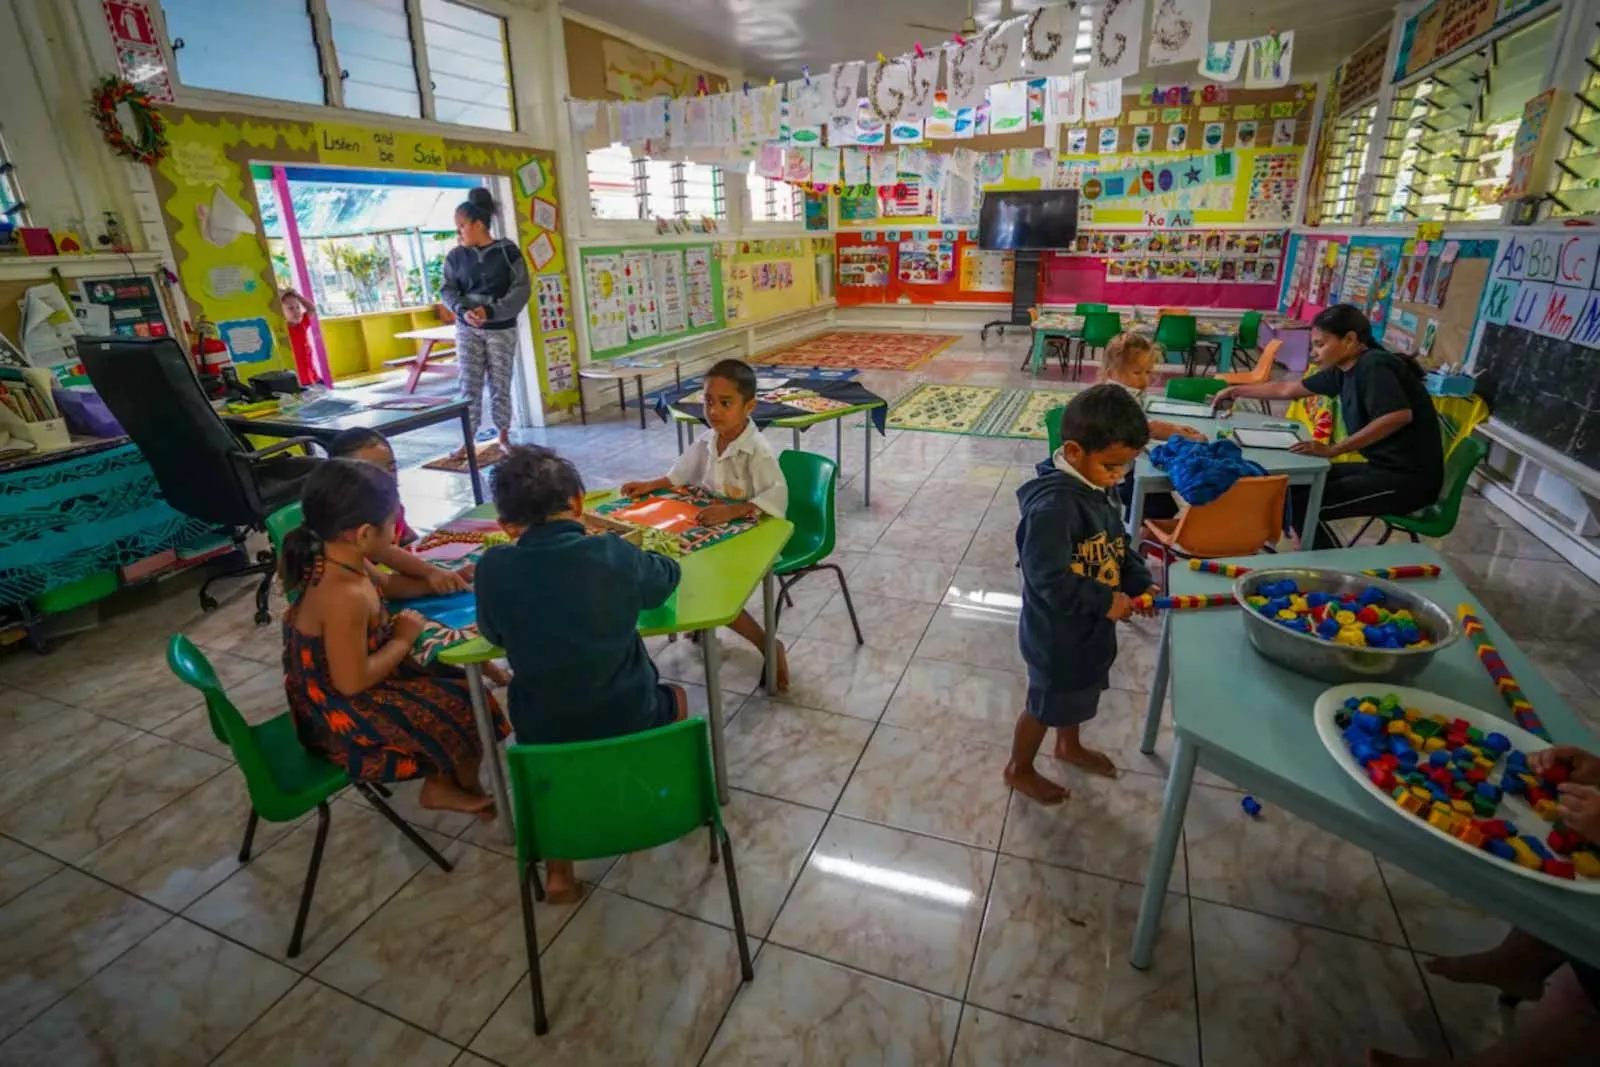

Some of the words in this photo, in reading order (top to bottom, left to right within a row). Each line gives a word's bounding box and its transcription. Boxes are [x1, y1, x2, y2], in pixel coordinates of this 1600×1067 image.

[323, 130, 360, 153] Listen
[373, 132, 394, 146] and
[379, 148, 395, 163] be
[414, 143, 442, 166] Safe
[1147, 213, 1165, 226] Ko
[1171, 213, 1191, 227] Au
[1496, 236, 1525, 276] Aa
[1527, 238, 1554, 277] Bb
[1562, 236, 1587, 281] Cc
[1483, 282, 1510, 319] Kk
[1539, 291, 1573, 335] Mm
